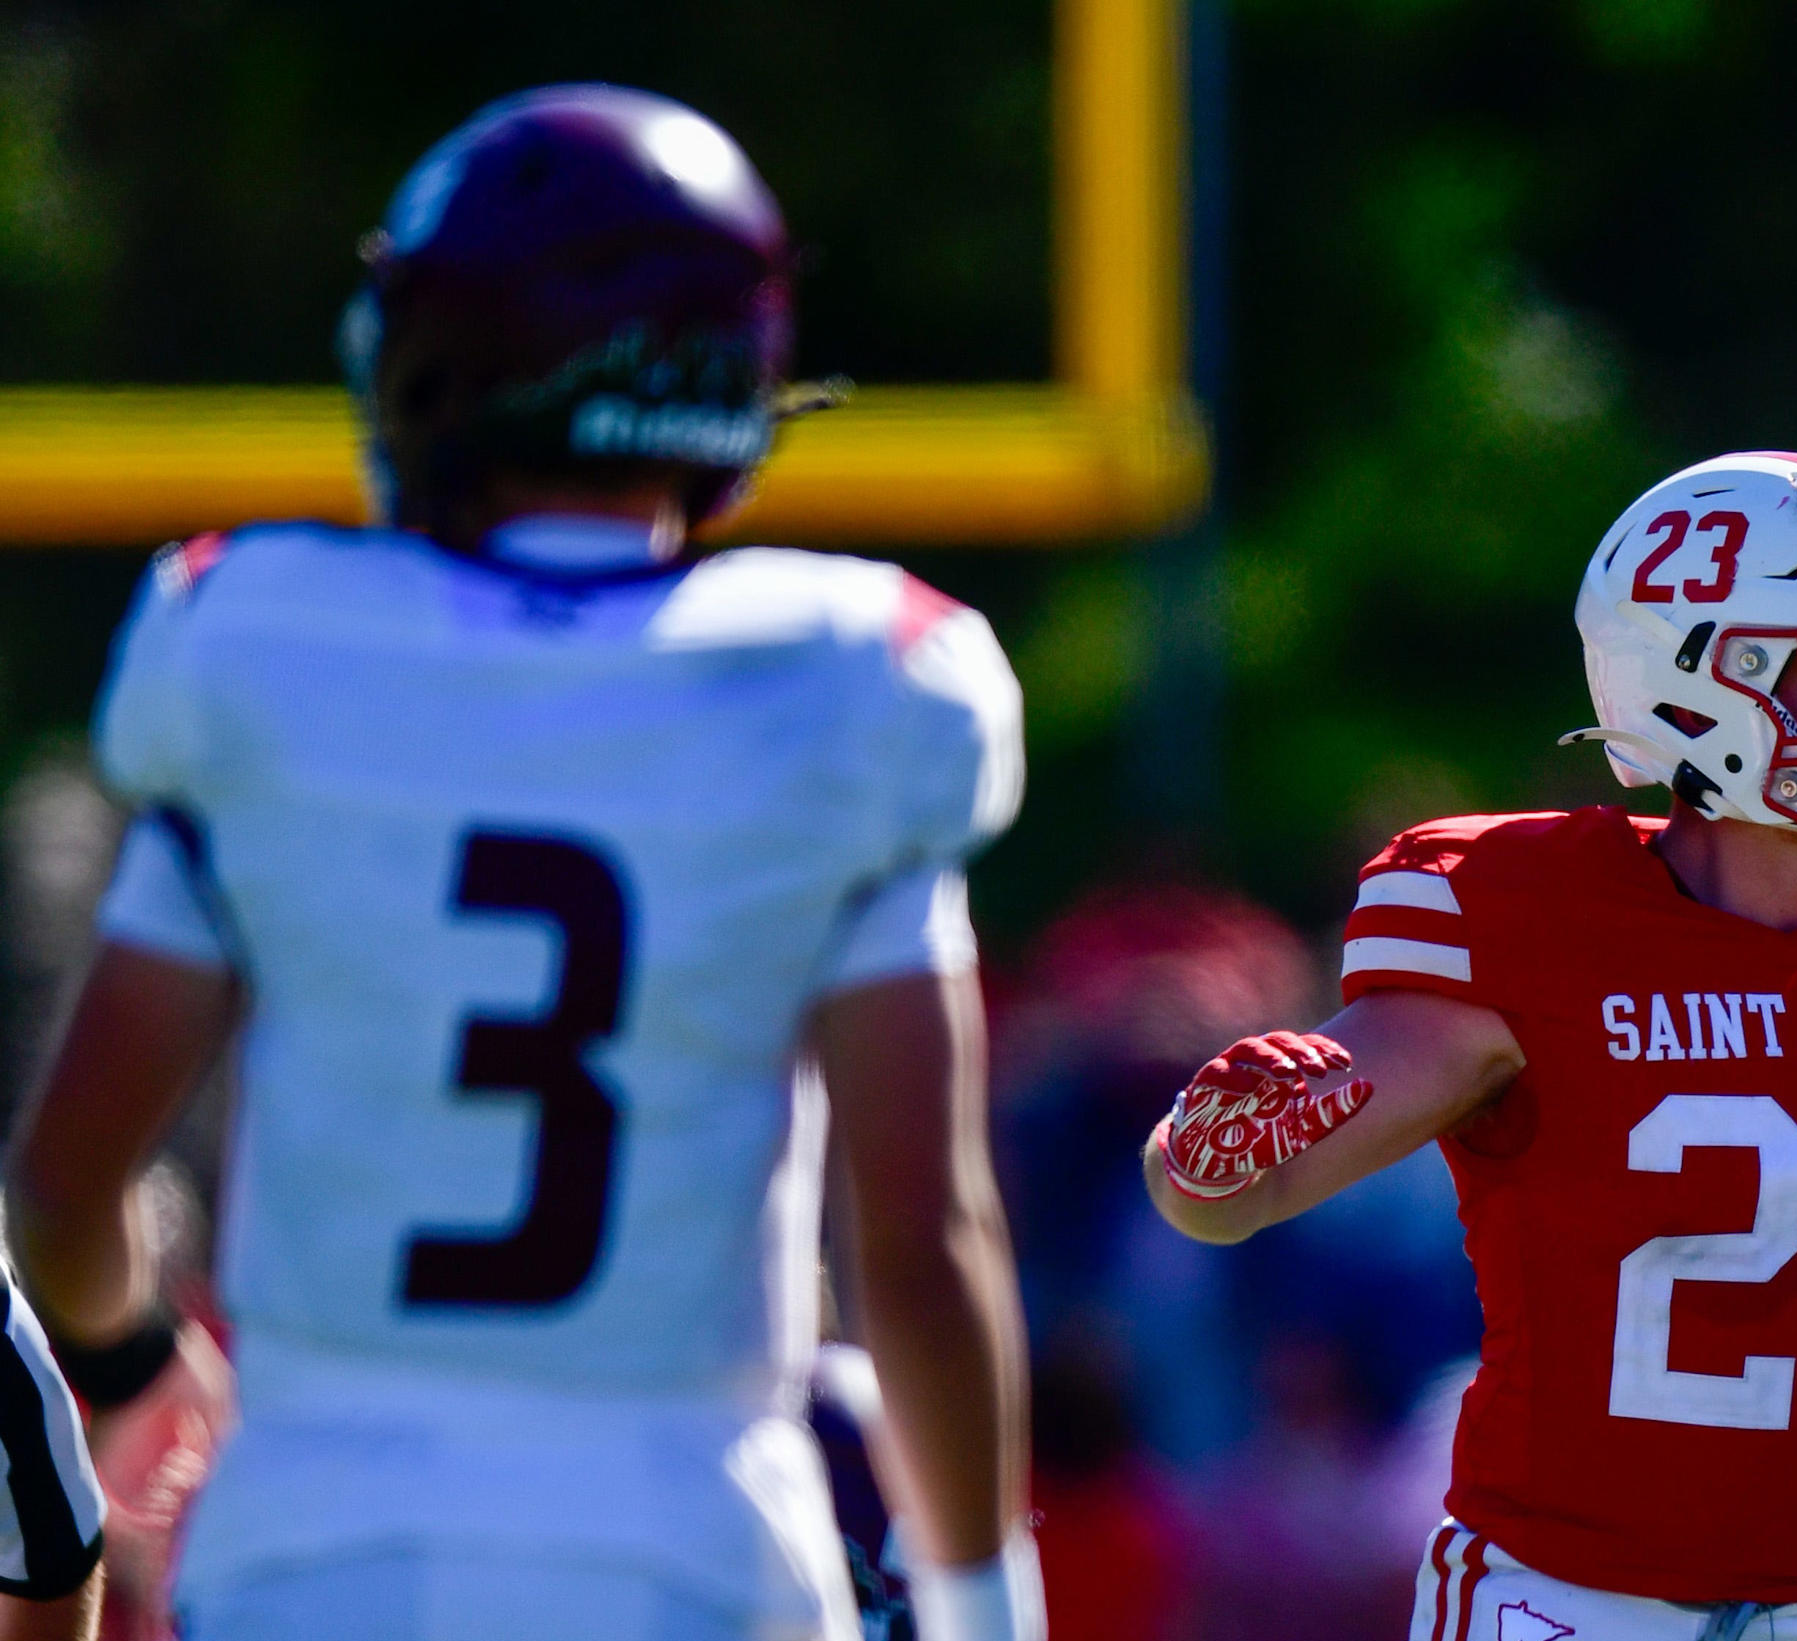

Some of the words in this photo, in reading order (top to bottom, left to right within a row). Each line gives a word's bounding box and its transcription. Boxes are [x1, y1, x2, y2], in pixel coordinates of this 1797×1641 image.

[1631, 509, 1751, 604] 23
[396, 823, 638, 1315] 3
[1601, 992, 1786, 1062] SAINT
